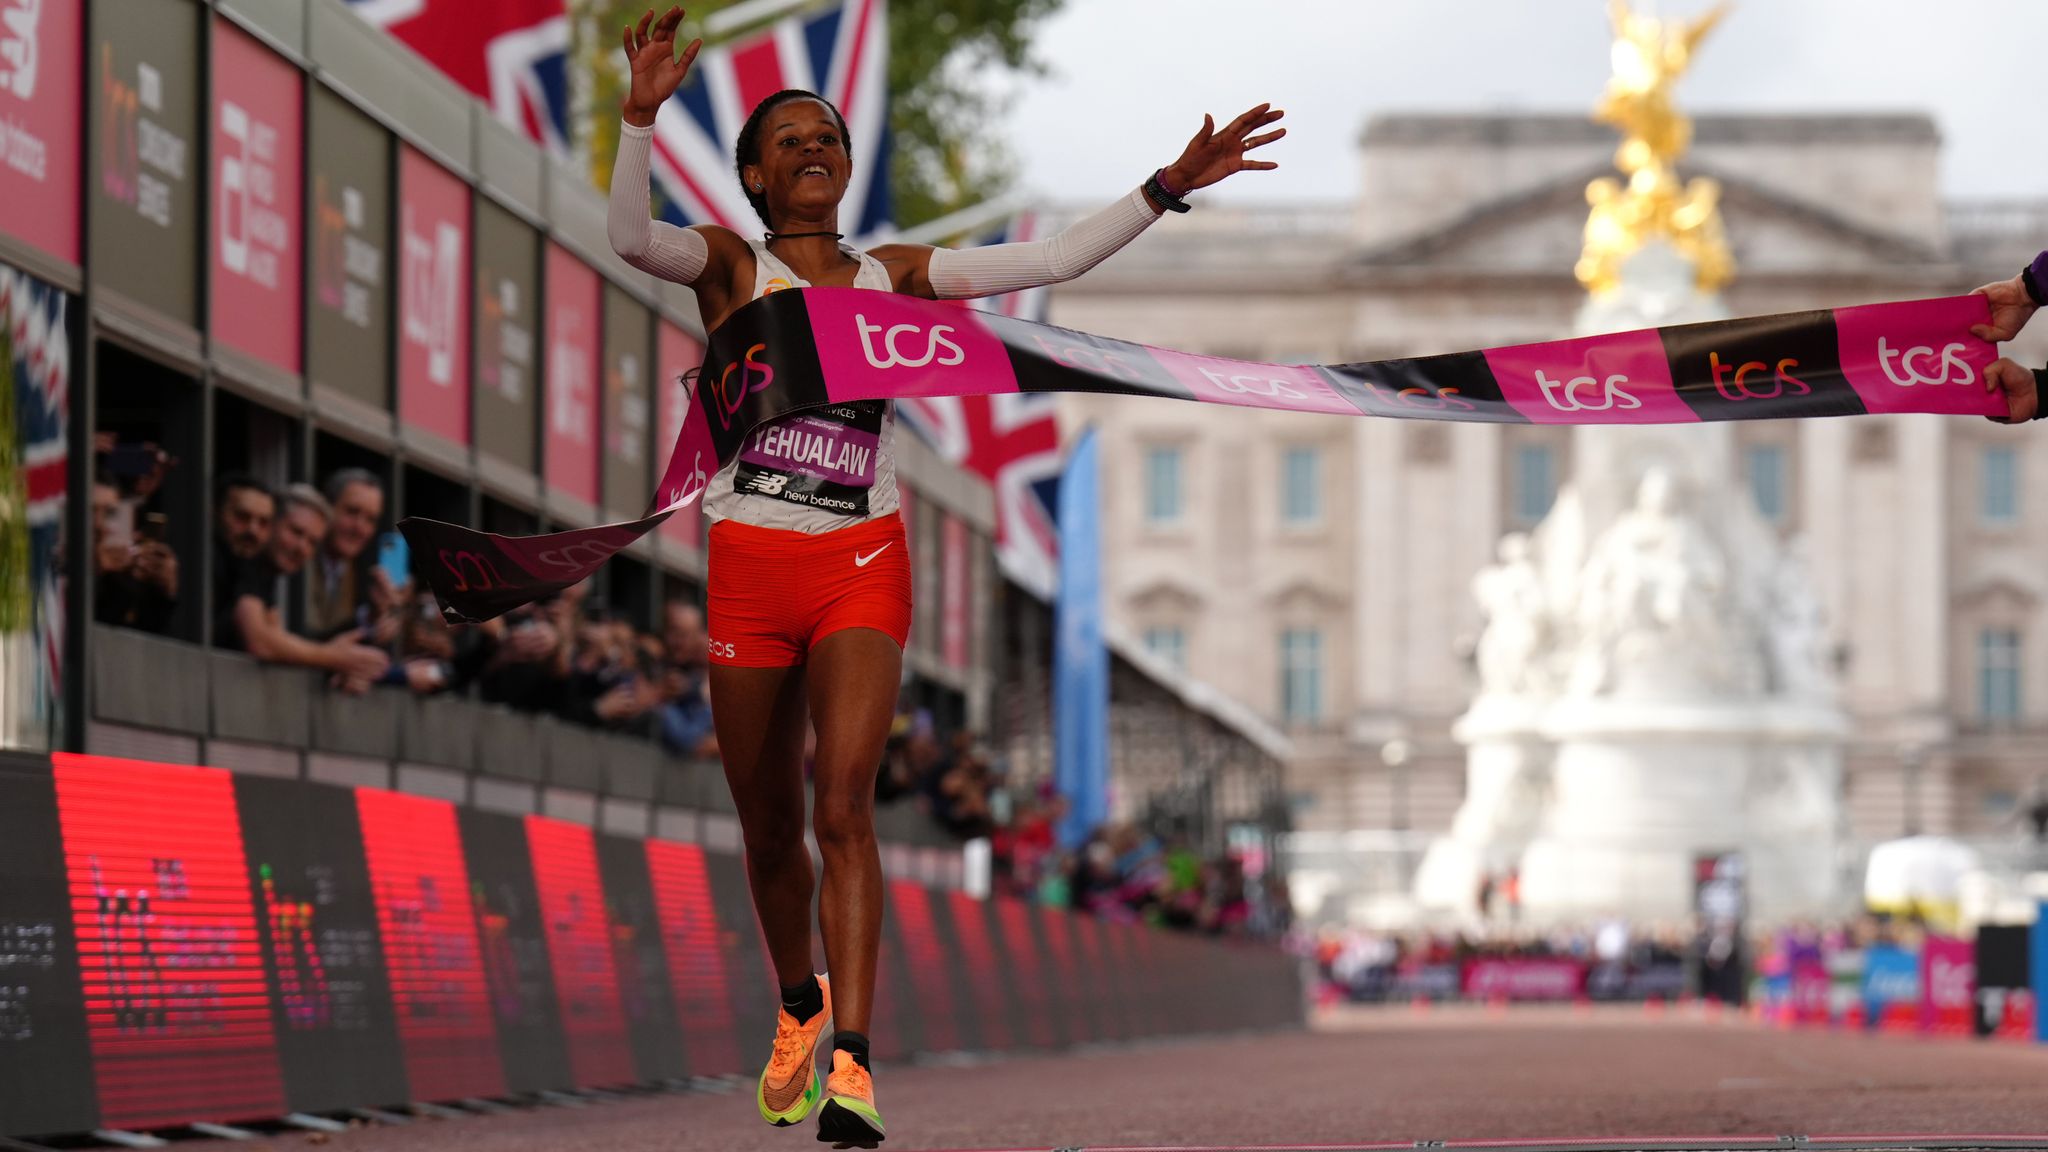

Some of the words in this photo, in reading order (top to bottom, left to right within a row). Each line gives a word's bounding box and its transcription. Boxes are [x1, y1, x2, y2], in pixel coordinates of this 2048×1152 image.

[855, 313, 965, 369] tcs
[1878, 336, 1975, 387] tcs
[711, 343, 774, 432] tcs
[1197, 367, 1309, 400] tcs
[1364, 382, 1476, 410] tcs
[1535, 370, 1642, 411] tcs
[1710, 352, 1811, 400] tcs
[754, 425, 871, 477] YEHUALAW
[784, 489, 809, 502] new
[810, 494, 856, 510] balance
